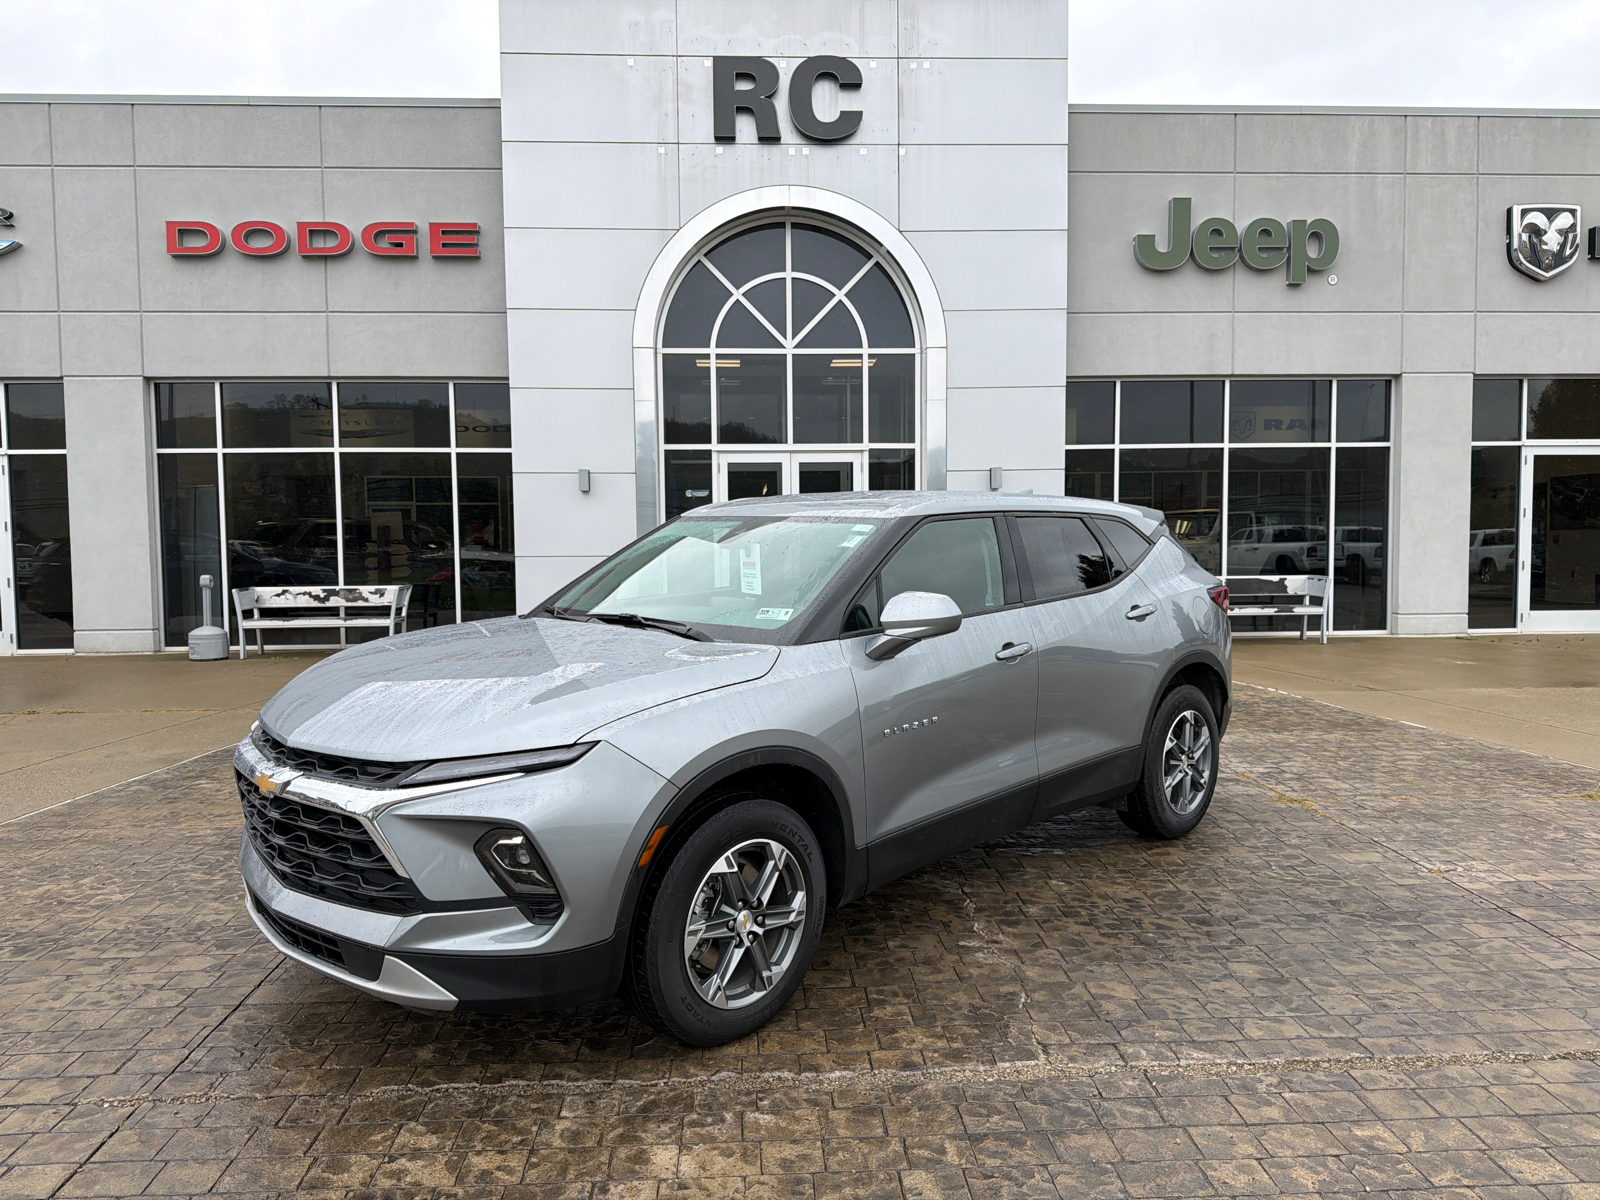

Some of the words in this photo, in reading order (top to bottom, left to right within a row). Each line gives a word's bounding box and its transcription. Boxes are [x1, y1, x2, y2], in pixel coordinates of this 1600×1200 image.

[713, 55, 863, 143] RC
[165, 220, 481, 259] DODGE
[1133, 197, 1340, 286] Jeep
[883, 716, 938, 737] BLAZER
